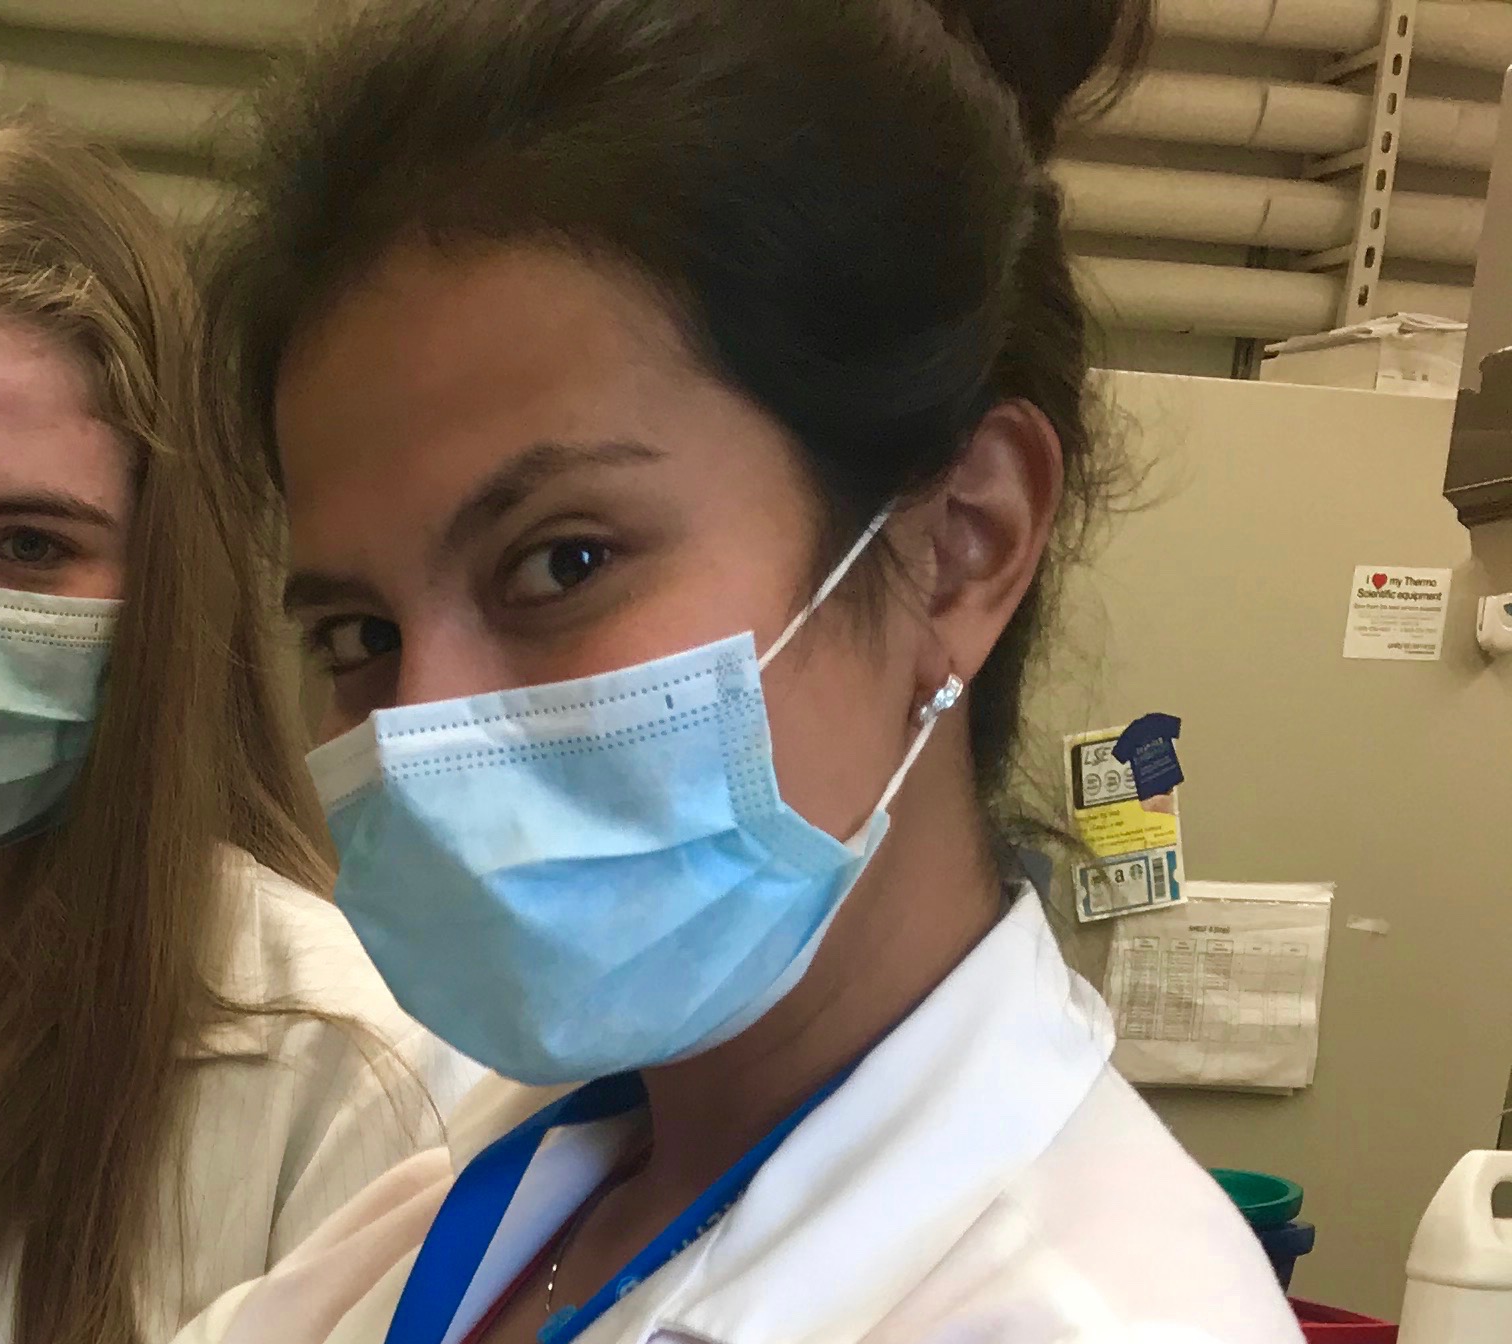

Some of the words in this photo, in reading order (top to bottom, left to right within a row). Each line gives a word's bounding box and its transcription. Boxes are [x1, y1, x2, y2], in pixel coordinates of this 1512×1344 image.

[1389, 577, 1402, 587] my
[1405, 576, 1436, 587] Thermo
[1357, 588, 1396, 599] Scientific
[1397, 592, 1442, 601] equipment
